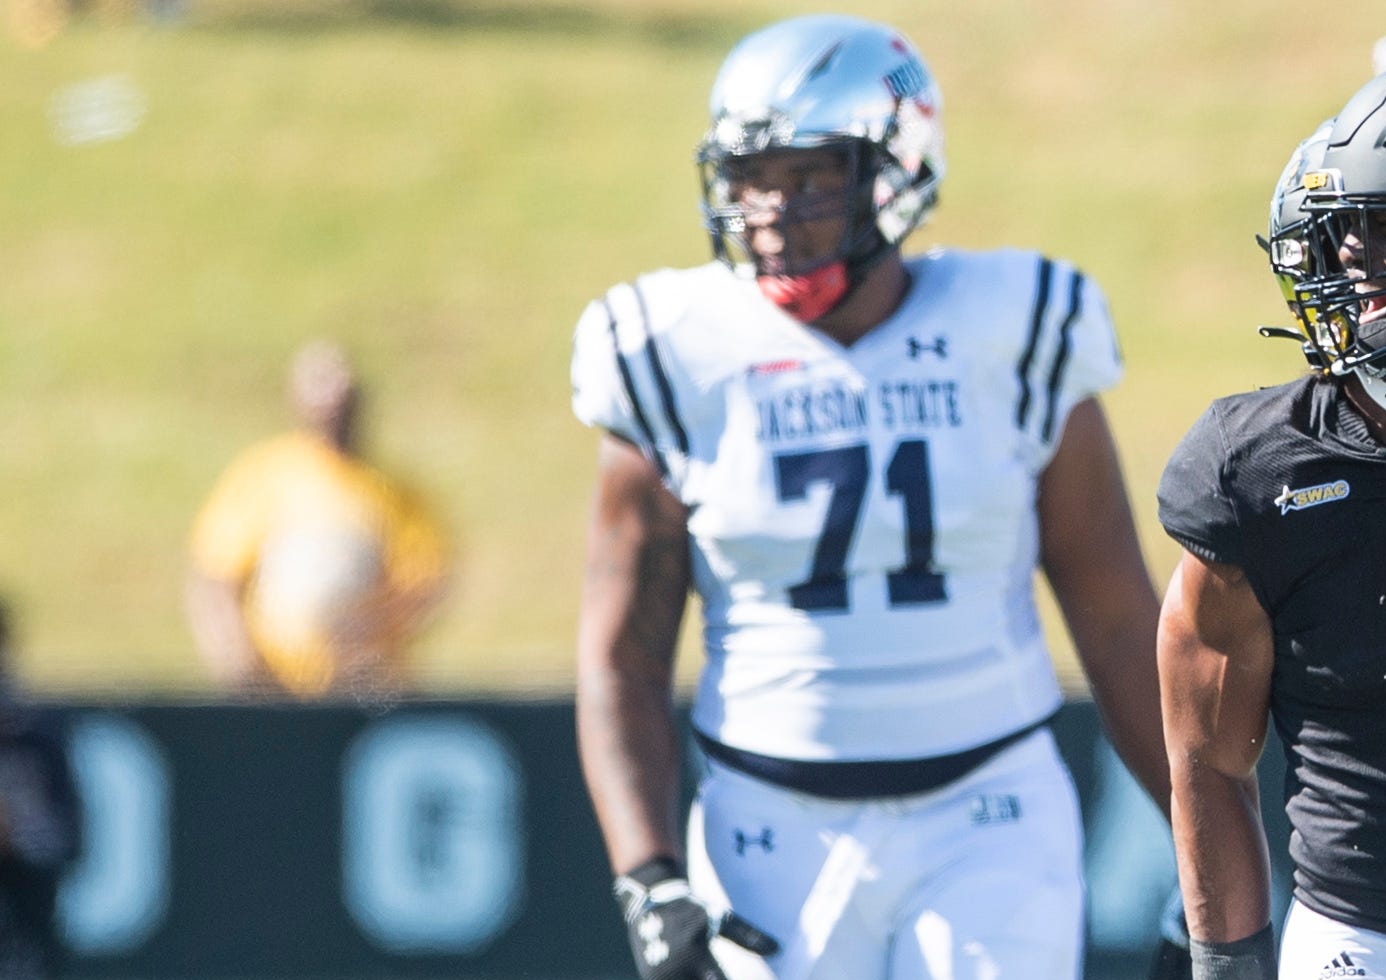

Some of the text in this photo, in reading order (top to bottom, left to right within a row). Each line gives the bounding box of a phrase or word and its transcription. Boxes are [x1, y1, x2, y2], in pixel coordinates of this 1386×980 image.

[756, 379, 962, 440] JACKSON STATE
[1296, 482, 1346, 507] SWAC
[775, 439, 949, 612] 71
